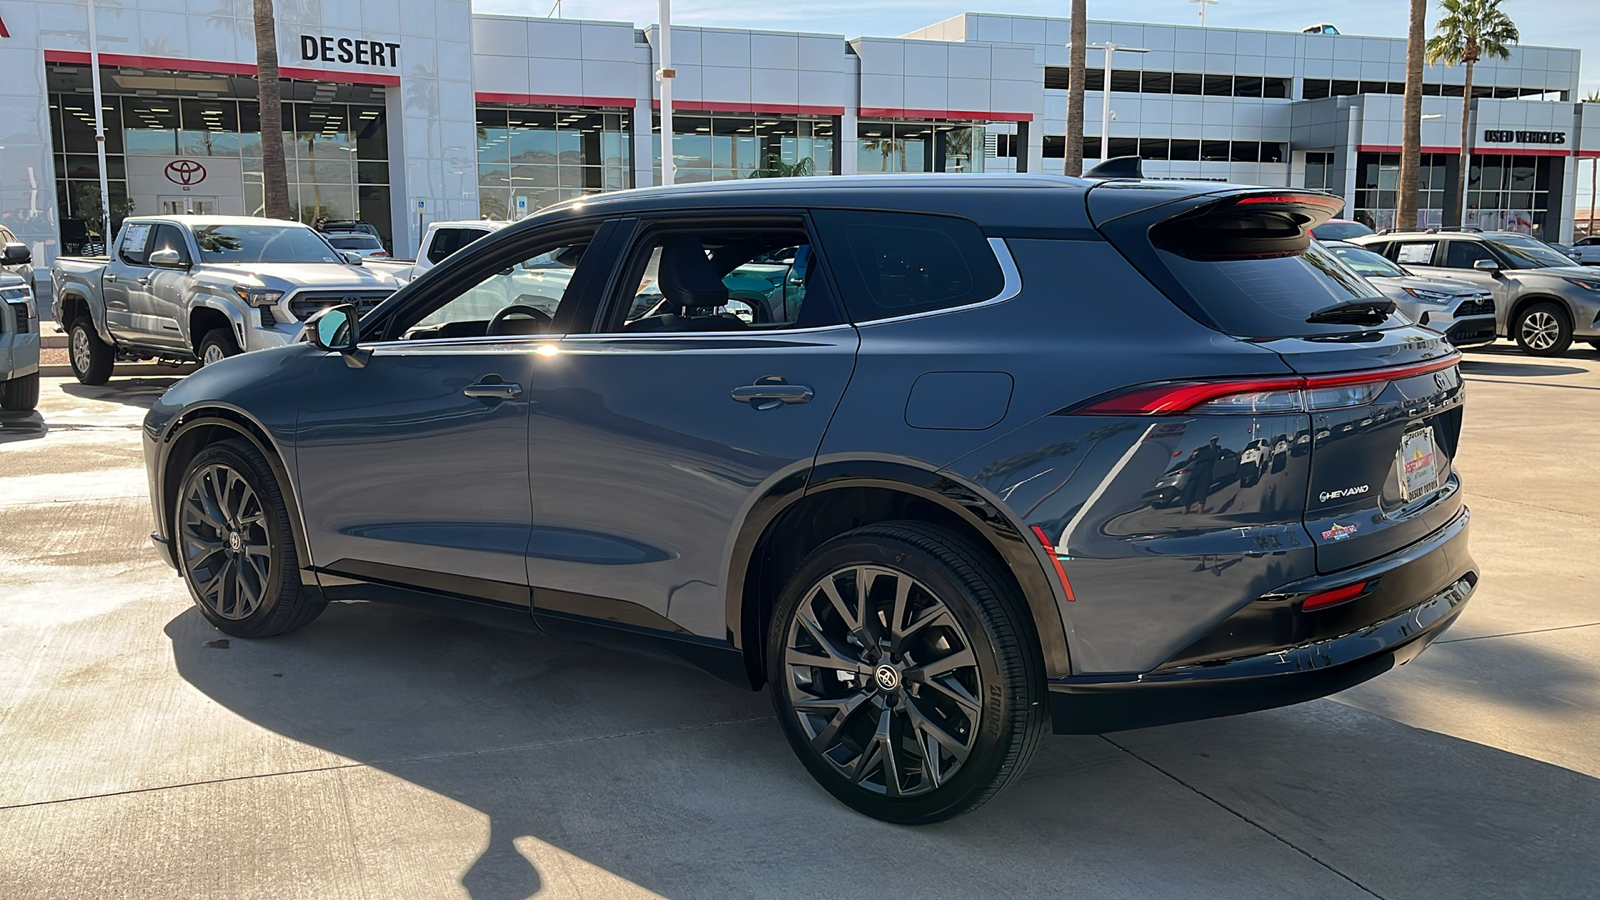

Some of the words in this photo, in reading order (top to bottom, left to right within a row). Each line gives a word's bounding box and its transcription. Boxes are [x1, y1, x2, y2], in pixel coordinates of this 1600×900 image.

[301, 34, 400, 67] DESERT
[1484, 130, 1514, 143] USED
[1515, 131, 1566, 144] VEHICLES
